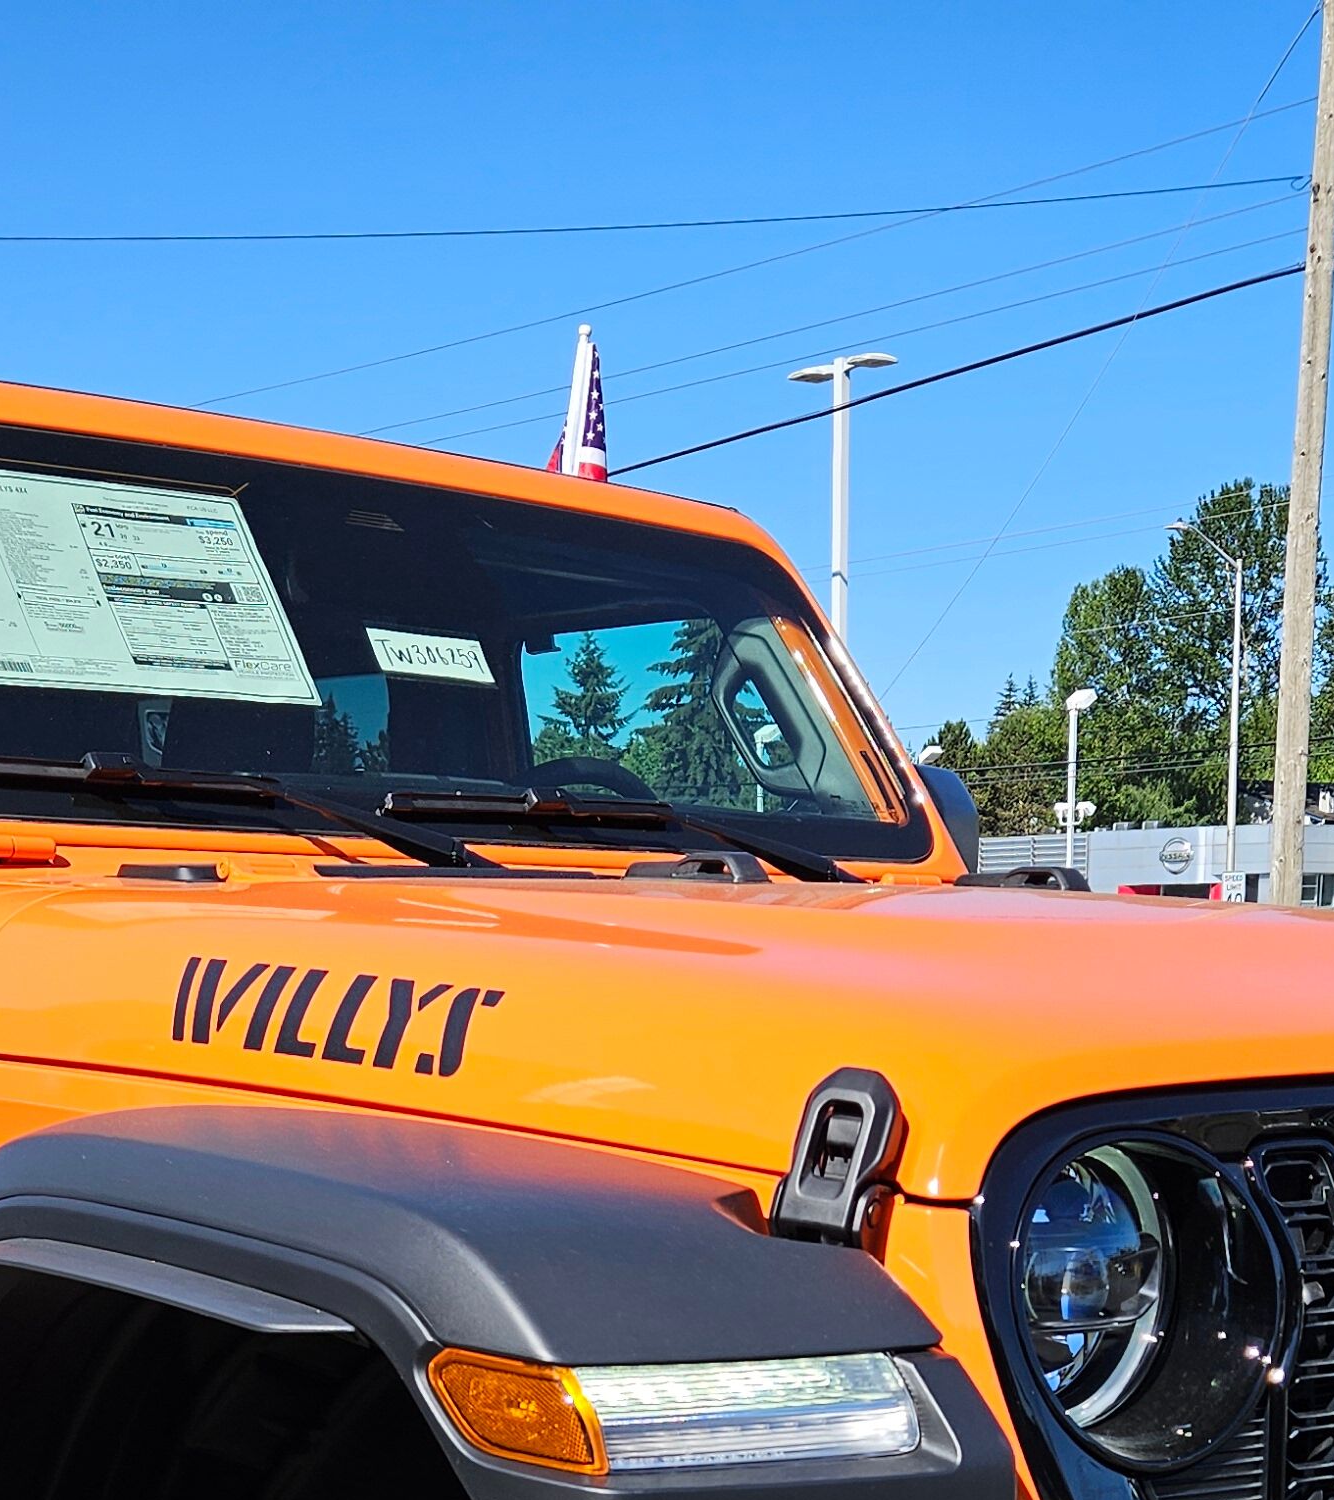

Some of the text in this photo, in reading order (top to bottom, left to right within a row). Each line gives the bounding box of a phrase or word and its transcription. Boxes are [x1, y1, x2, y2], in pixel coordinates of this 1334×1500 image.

[91, 521, 115, 538] 21
[198, 535, 233, 547] $3,250
[95, 558, 132, 570] $2,350
[374, 639, 485, 674] TW306259
[234, 659, 292, 672] FlexCare
[1160, 852, 1192, 860] NISSAN
[1227, 883, 1242, 891] LIMIT
[172, 956, 506, 1078] WILLYS
